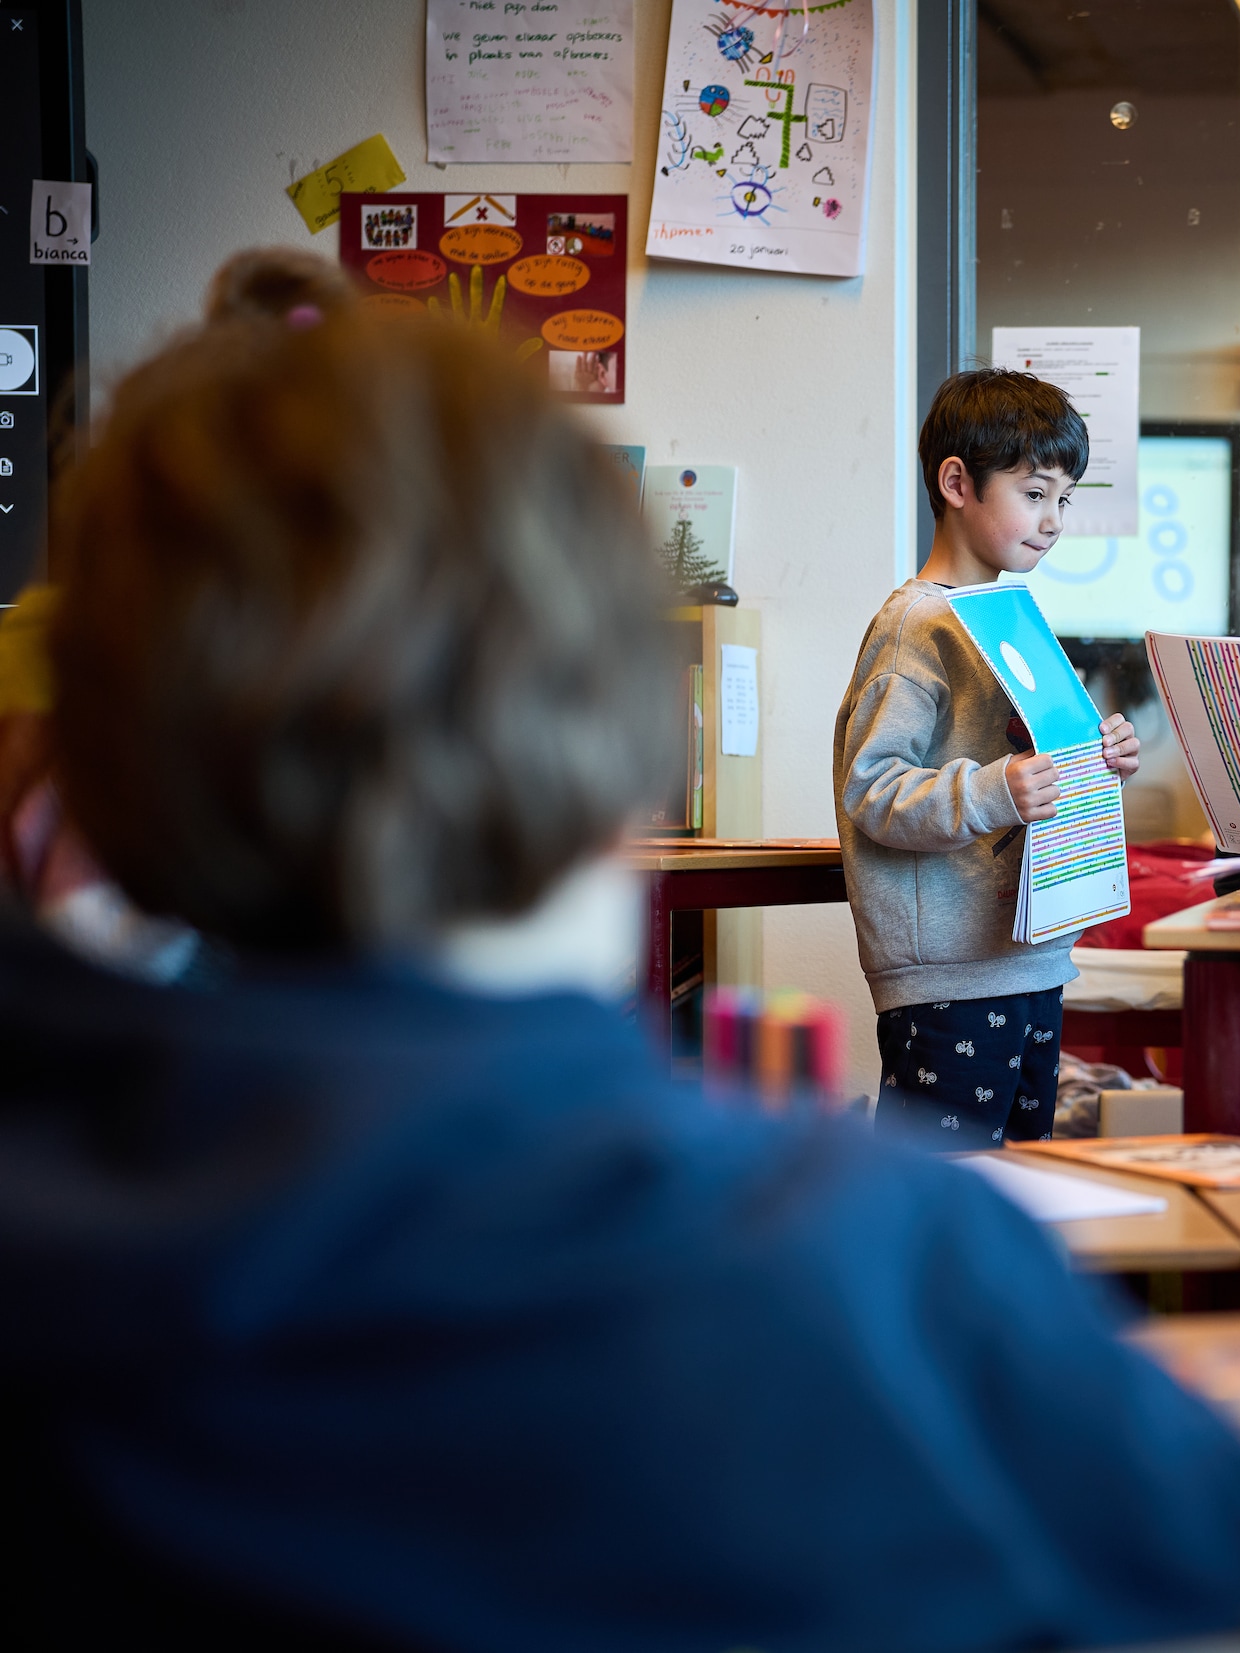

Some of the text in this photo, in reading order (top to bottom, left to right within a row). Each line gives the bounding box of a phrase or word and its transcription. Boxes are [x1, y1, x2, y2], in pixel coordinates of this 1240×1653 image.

[473, 33, 509, 47] geven
[515, 31, 558, 42] elkaar
[325, 164, 344, 197] 5
[46, 195, 68, 237] b
[34, 241, 88, 262] bianca
[730, 243, 789, 259] 20 januari
